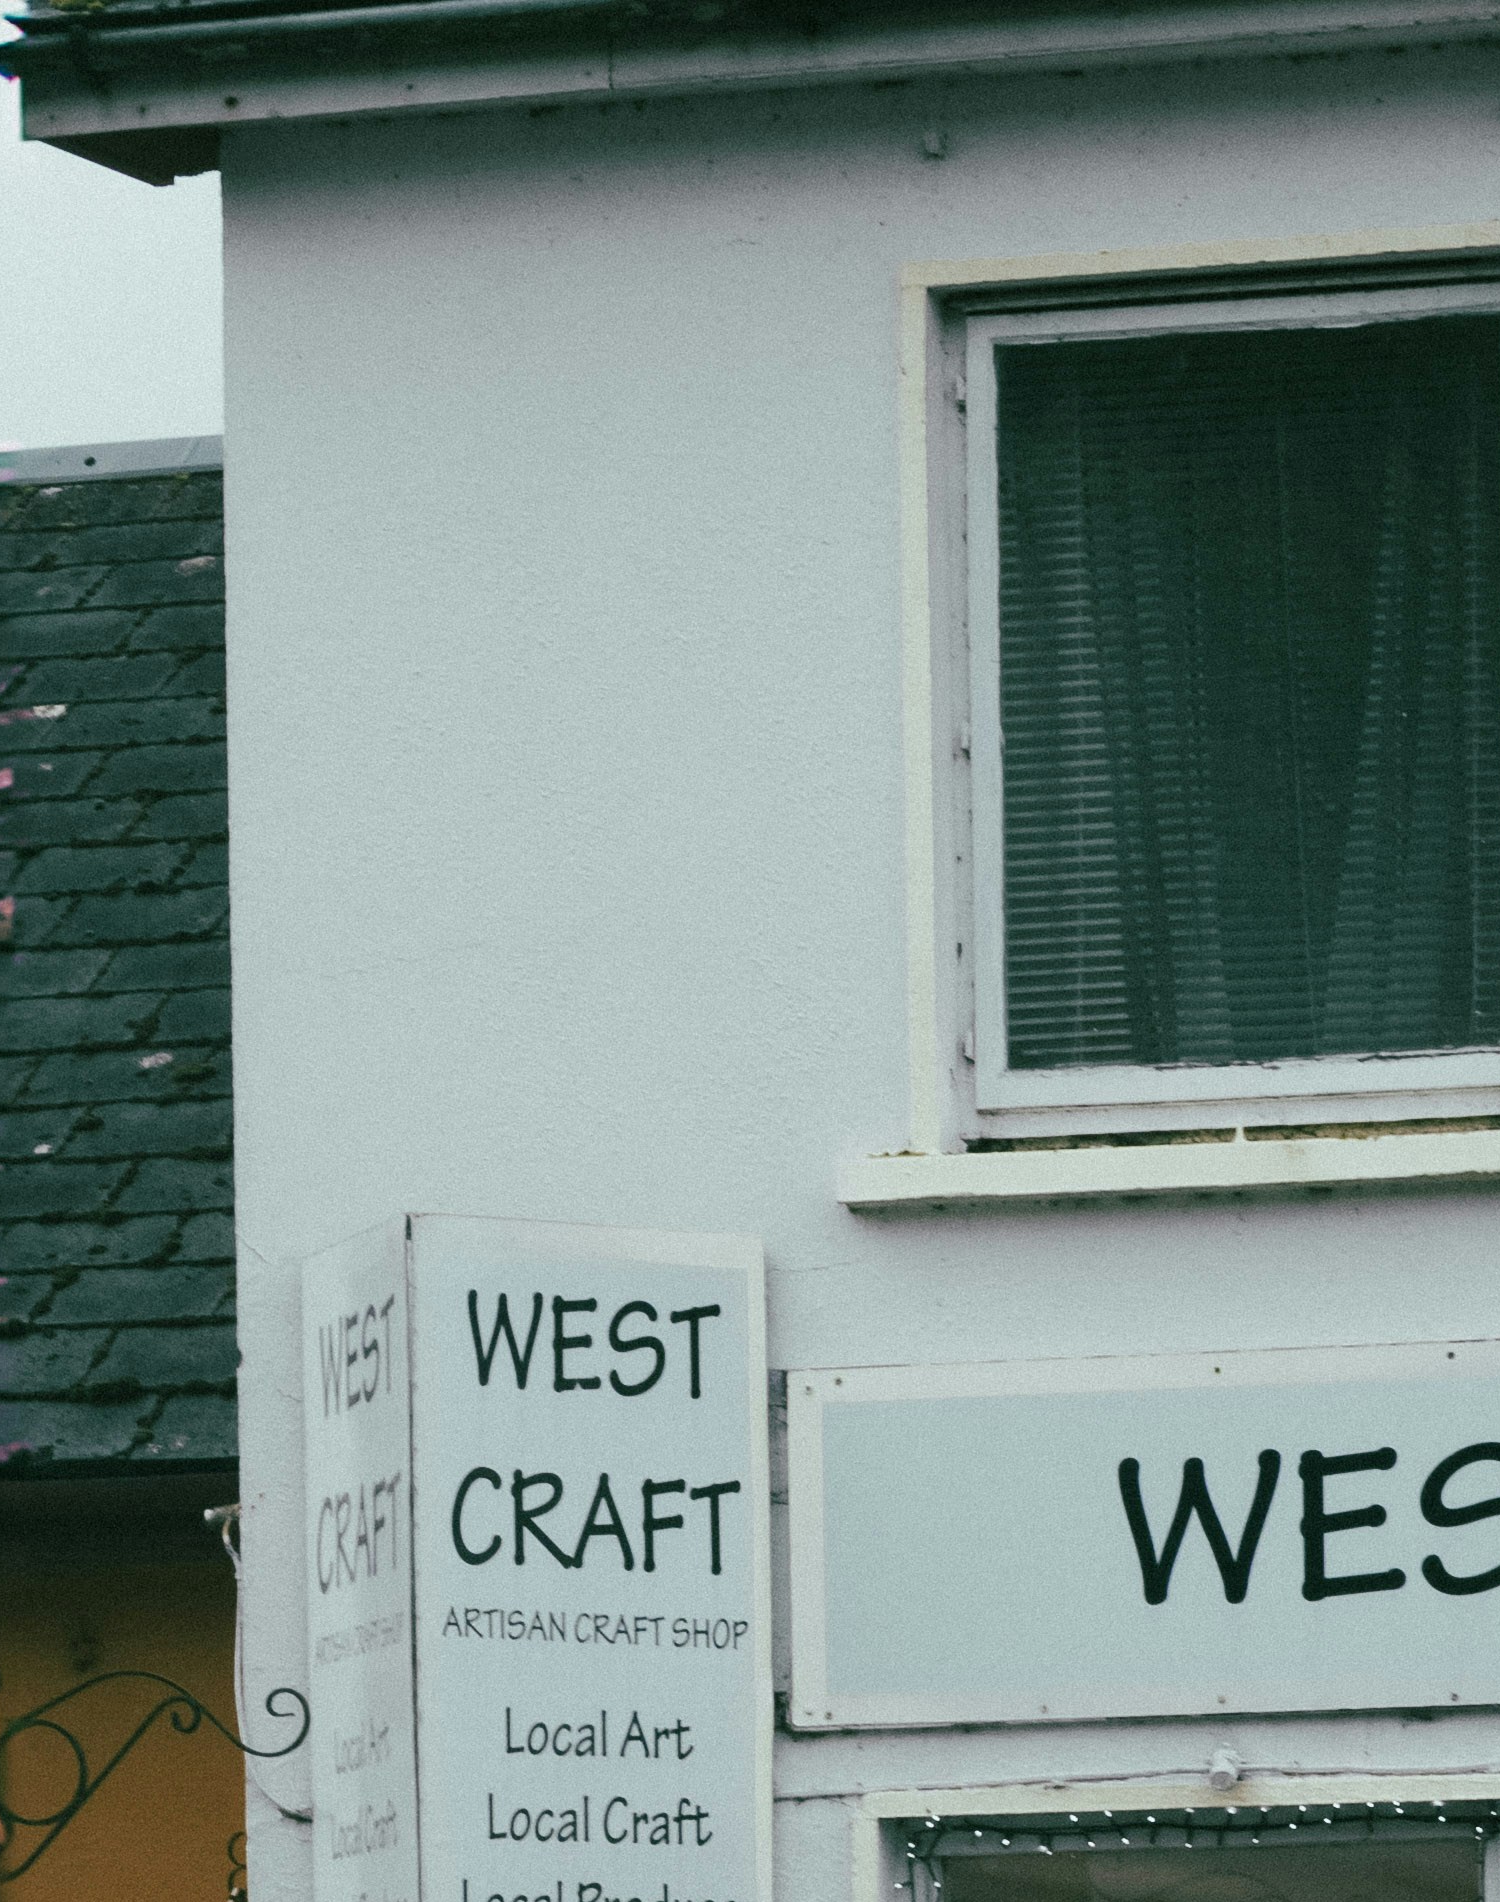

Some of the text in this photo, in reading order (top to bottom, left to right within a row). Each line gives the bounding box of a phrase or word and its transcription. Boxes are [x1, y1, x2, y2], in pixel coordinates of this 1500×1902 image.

[318, 1293, 395, 1417] WEST
[468, 1290, 720, 1399] WEST
[317, 1473, 400, 1594] CRAFT
[452, 1467, 740, 1575] CRAFT
[444, 1608, 748, 1649] ARTISAN CRAFT SHOP
[506, 1708, 693, 1760] Local Art
[489, 1794, 712, 1846] Local Craft
